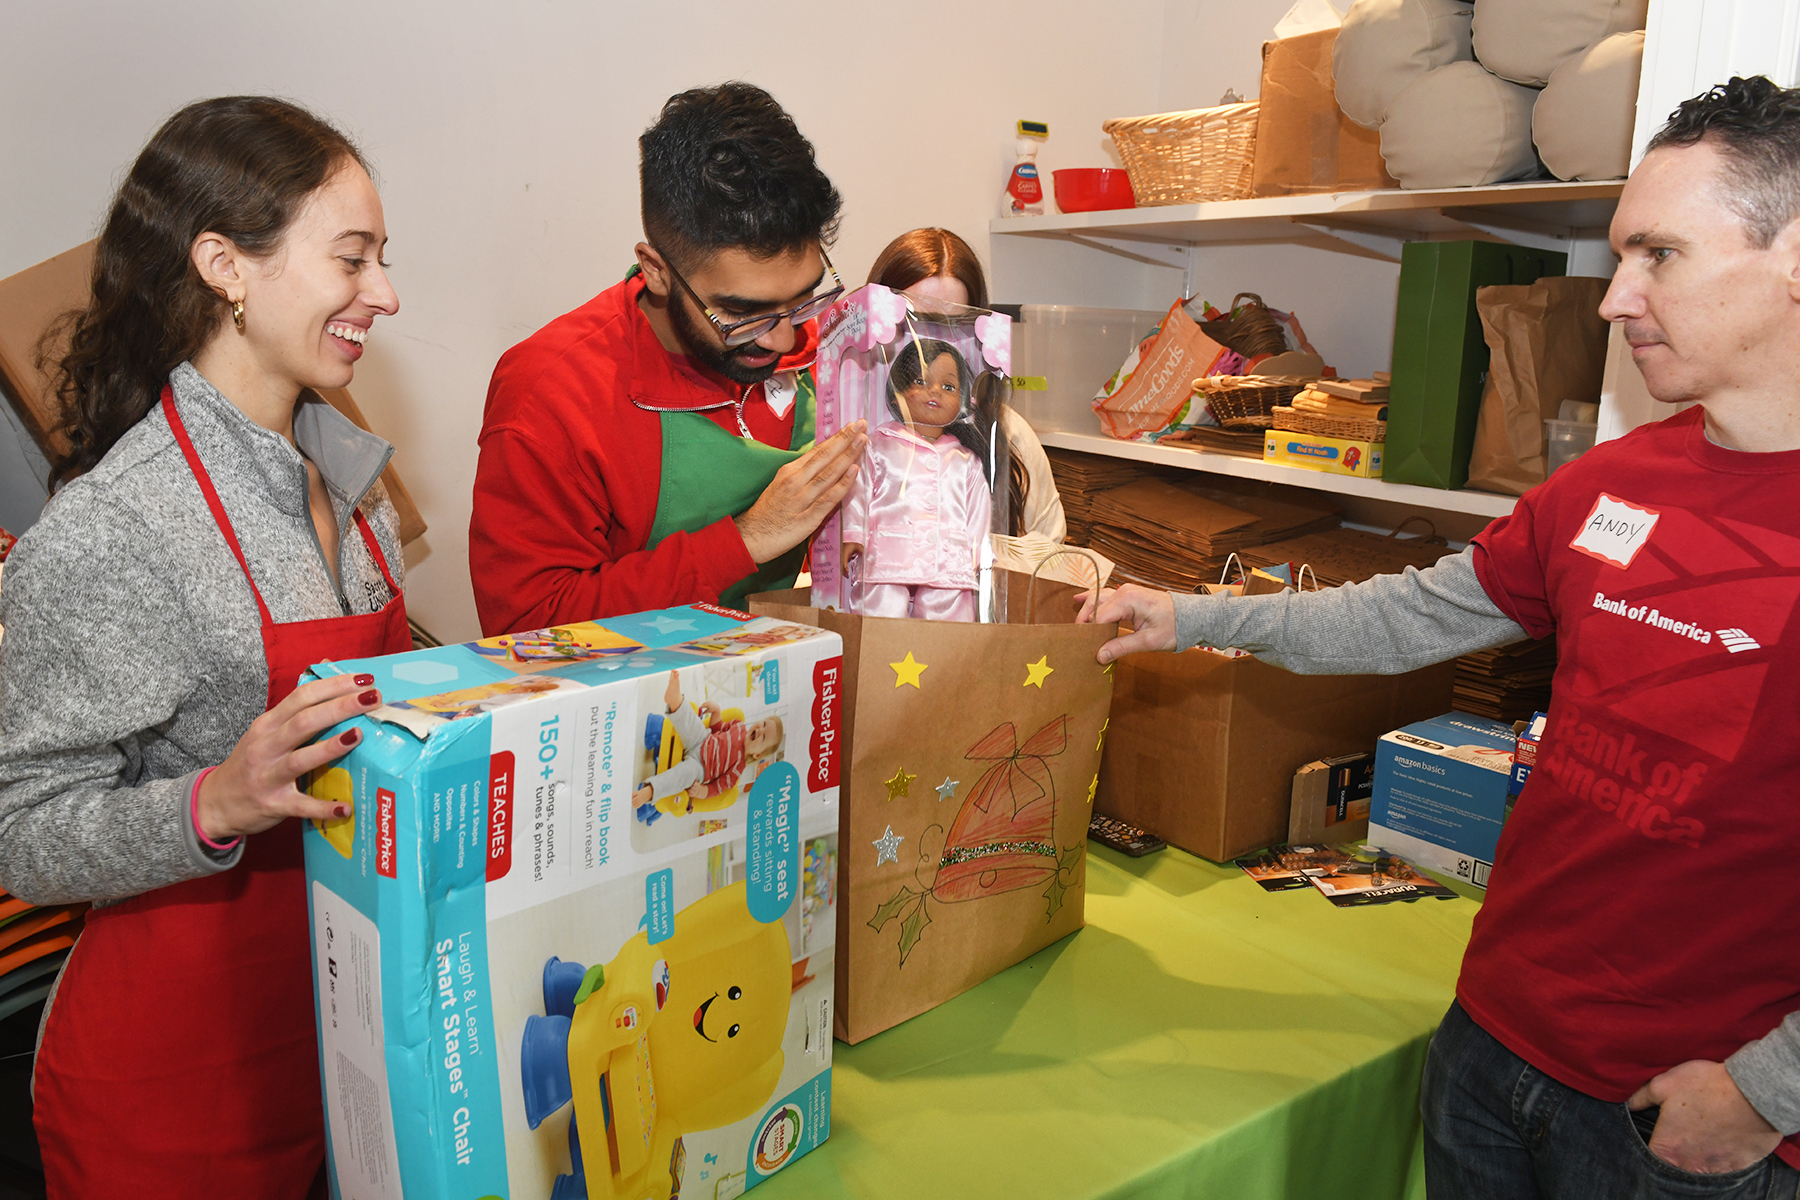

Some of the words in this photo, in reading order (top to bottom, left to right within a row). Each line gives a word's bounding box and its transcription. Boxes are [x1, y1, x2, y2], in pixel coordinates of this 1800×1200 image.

[1588, 513, 1645, 544] ANDY
[1593, 592, 1627, 617] Bank
[1627, 606, 1648, 622] of
[1645, 609, 1711, 644] America
[590, 706, 599, 726] put
[538, 714, 559, 780] 150+
[588, 729, 598, 748] the
[1554, 702, 1649, 784] Bank
[1651, 761, 1708, 805] of
[584, 751, 597, 798] learning
[1394, 756, 1421, 768] amazon
[1422, 761, 1446, 775] basics
[459, 783, 467, 822] Numbers
[473, 780, 481, 808] Colors
[534, 786, 543, 819] tunes
[545, 783, 555, 822] songs,
[600, 784, 611, 794] &
[1542, 743, 1706, 849] America
[445, 788, 454, 831] Opposites
[491, 772, 507, 859] TEACHES
[534, 821, 543, 831] &
[585, 800, 595, 819] fun
[585, 822, 593, 832] in
[598, 797, 611, 823] flip
[753, 810, 763, 820] &
[765, 793, 774, 848] rewards
[457, 831, 466, 869] Counting
[471, 816, 480, 847] Shapes
[545, 824, 556, 869] sounds,
[599, 826, 611, 867] book
[533, 833, 543, 882] phrases!
[584, 835, 594, 870] reach!
[750, 823, 762, 885] standing!
[763, 851, 774, 892] sitting
[777, 859, 789, 901] seat
[1362, 885, 1418, 898] DURACELL
[458, 931, 475, 986] Laugh
[463, 989, 477, 1003] &
[465, 1005, 480, 1055] Learn
[436, 938, 457, 1010] Smart
[453, 1106, 474, 1165] Chair
